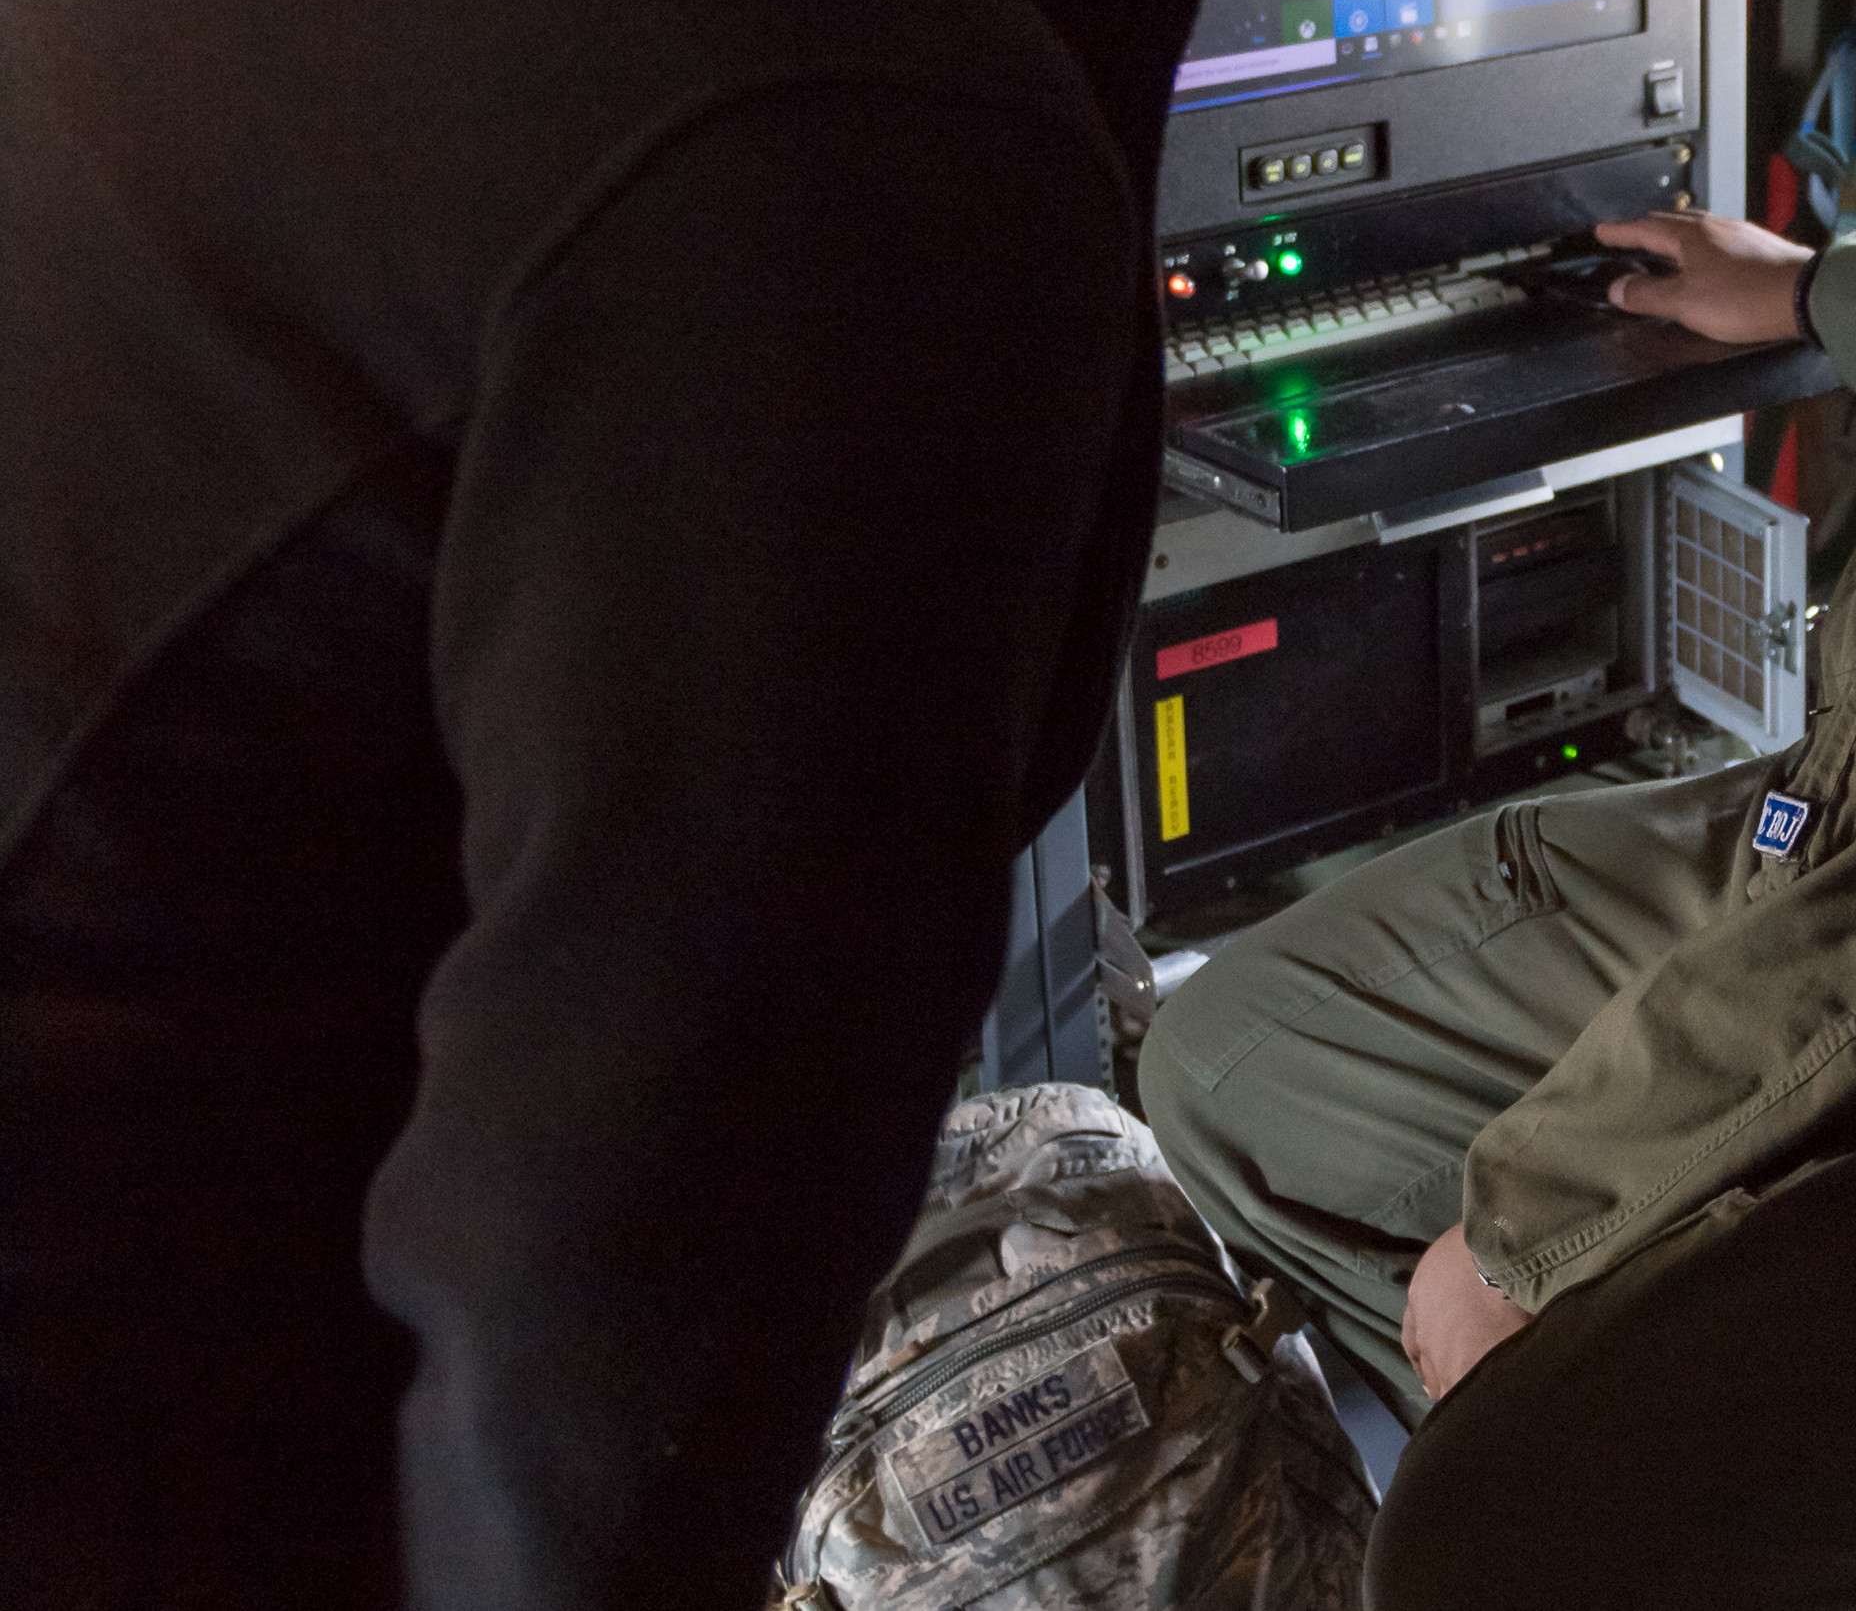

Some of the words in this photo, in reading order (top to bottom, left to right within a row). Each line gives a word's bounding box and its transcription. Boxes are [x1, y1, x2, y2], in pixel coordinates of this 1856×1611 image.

[1192, 633, 1242, 665] 8599
[952, 1374, 1071, 1461] BANKS
[986, 1451, 1044, 1506] AIR
[1040, 1392, 1140, 1473] FORCE
